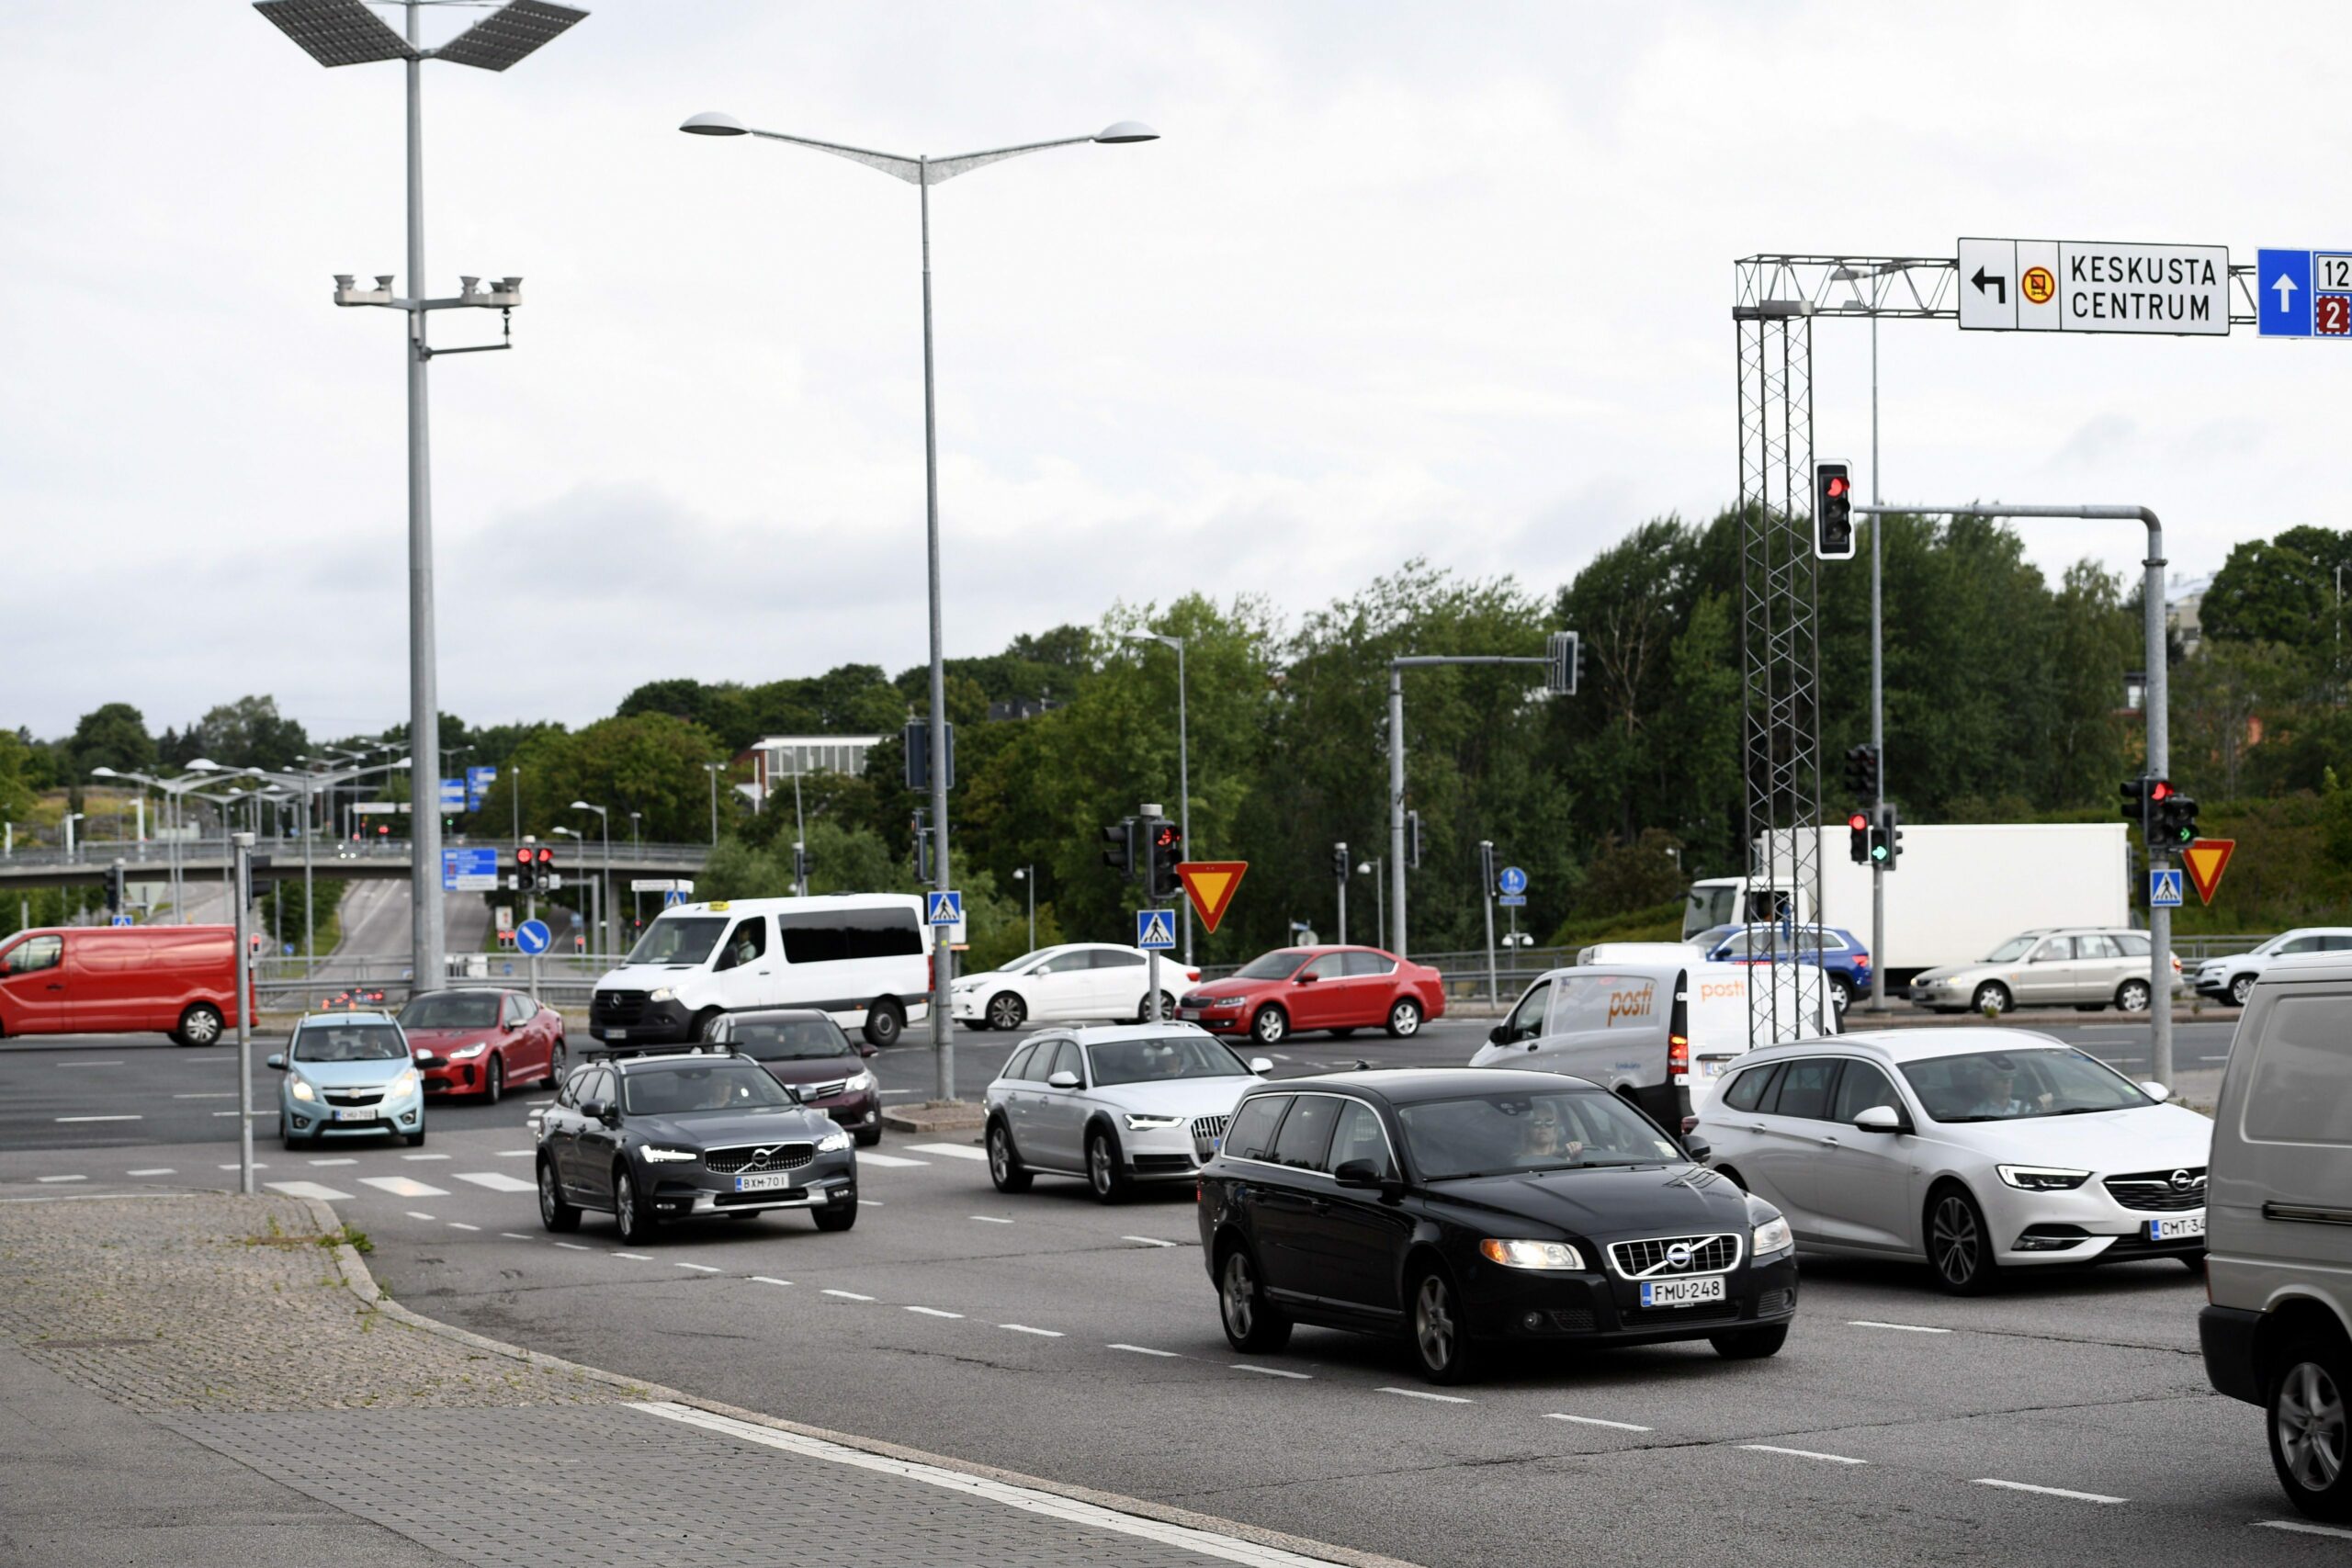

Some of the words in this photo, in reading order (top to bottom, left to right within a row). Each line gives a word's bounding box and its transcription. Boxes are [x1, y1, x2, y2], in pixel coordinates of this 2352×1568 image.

[2072, 255, 2216, 286] KESKUSTA
[2324, 260, 2349, 287] 12
[2073, 292, 2210, 321] CENTRUM
[2325, 301, 2340, 329] 2
[1702, 980, 1745, 1002] posti
[1607, 983, 1653, 1027] posti
[743, 1176, 785, 1189] BXM-701
[1655, 1280, 1720, 1301] FMU-248
